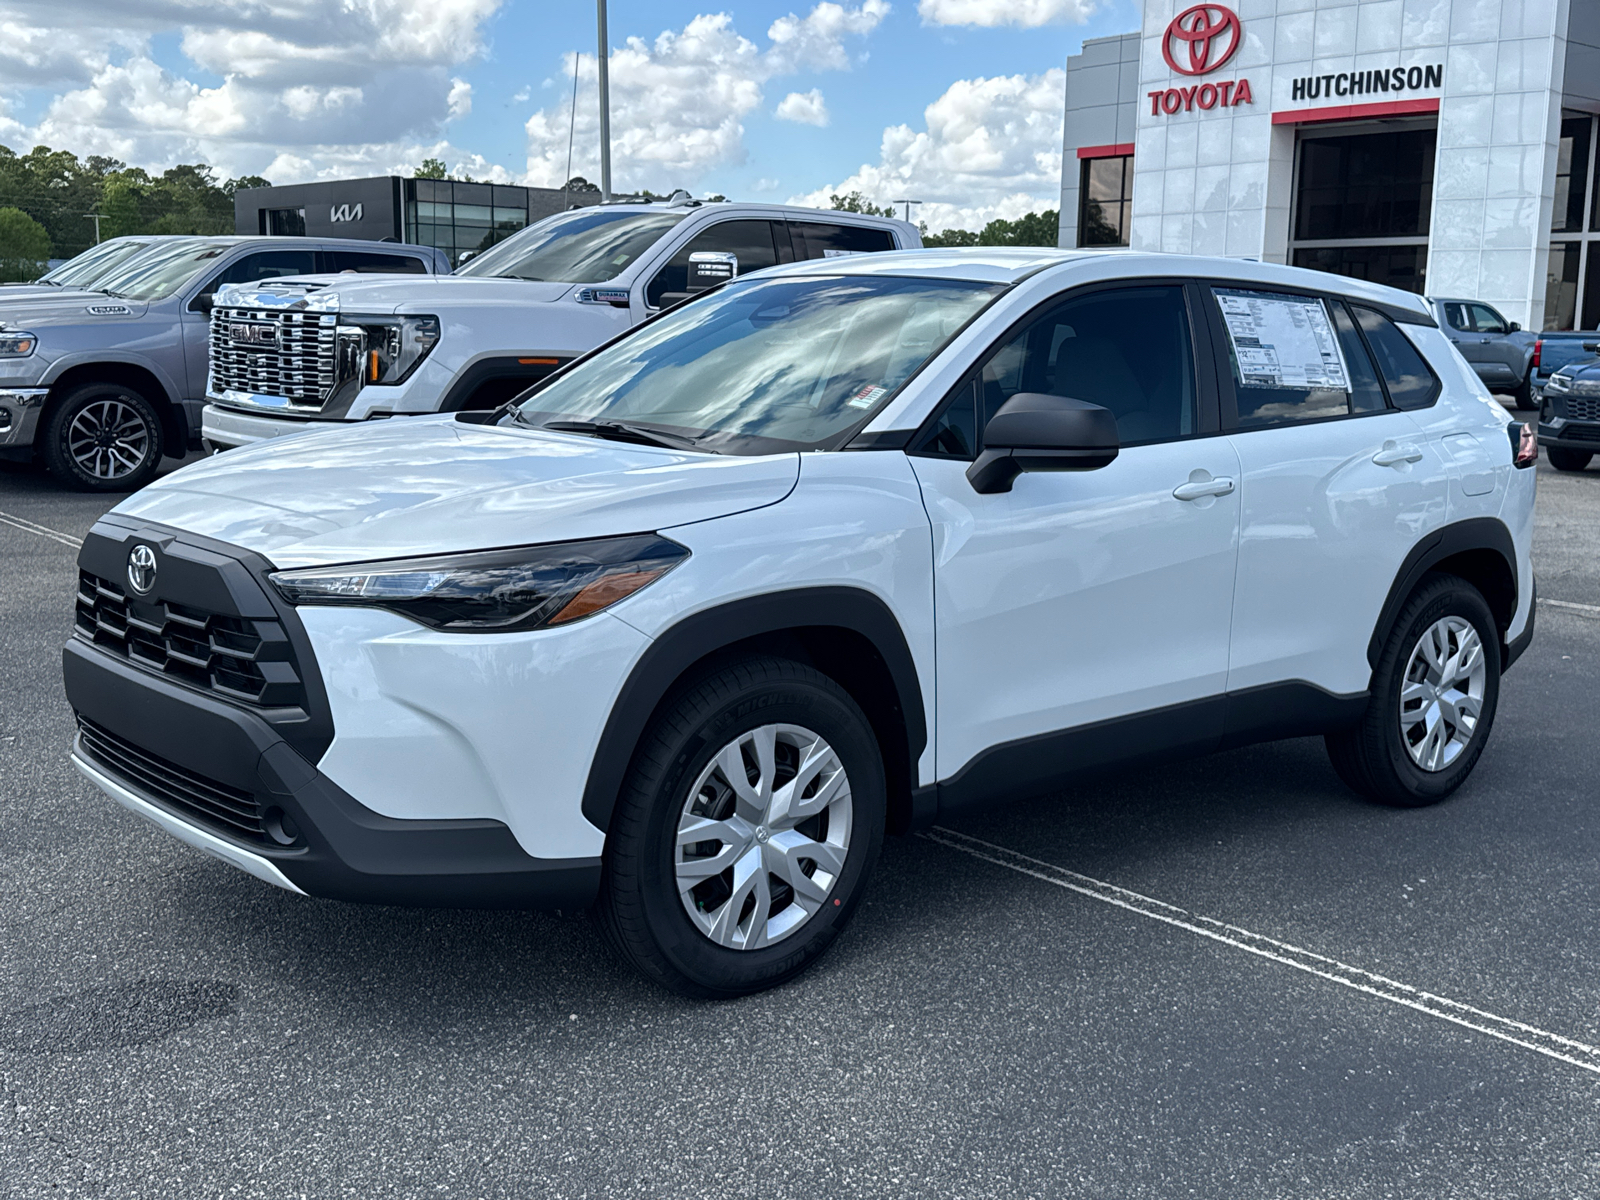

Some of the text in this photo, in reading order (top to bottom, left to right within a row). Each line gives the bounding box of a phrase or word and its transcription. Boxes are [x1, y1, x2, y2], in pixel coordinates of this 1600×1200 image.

[1292, 64, 1443, 101] HUTCHINSON
[1148, 79, 1252, 116] TOYOTA
[331, 203, 363, 222] KIA
[230, 324, 275, 343] GMC
